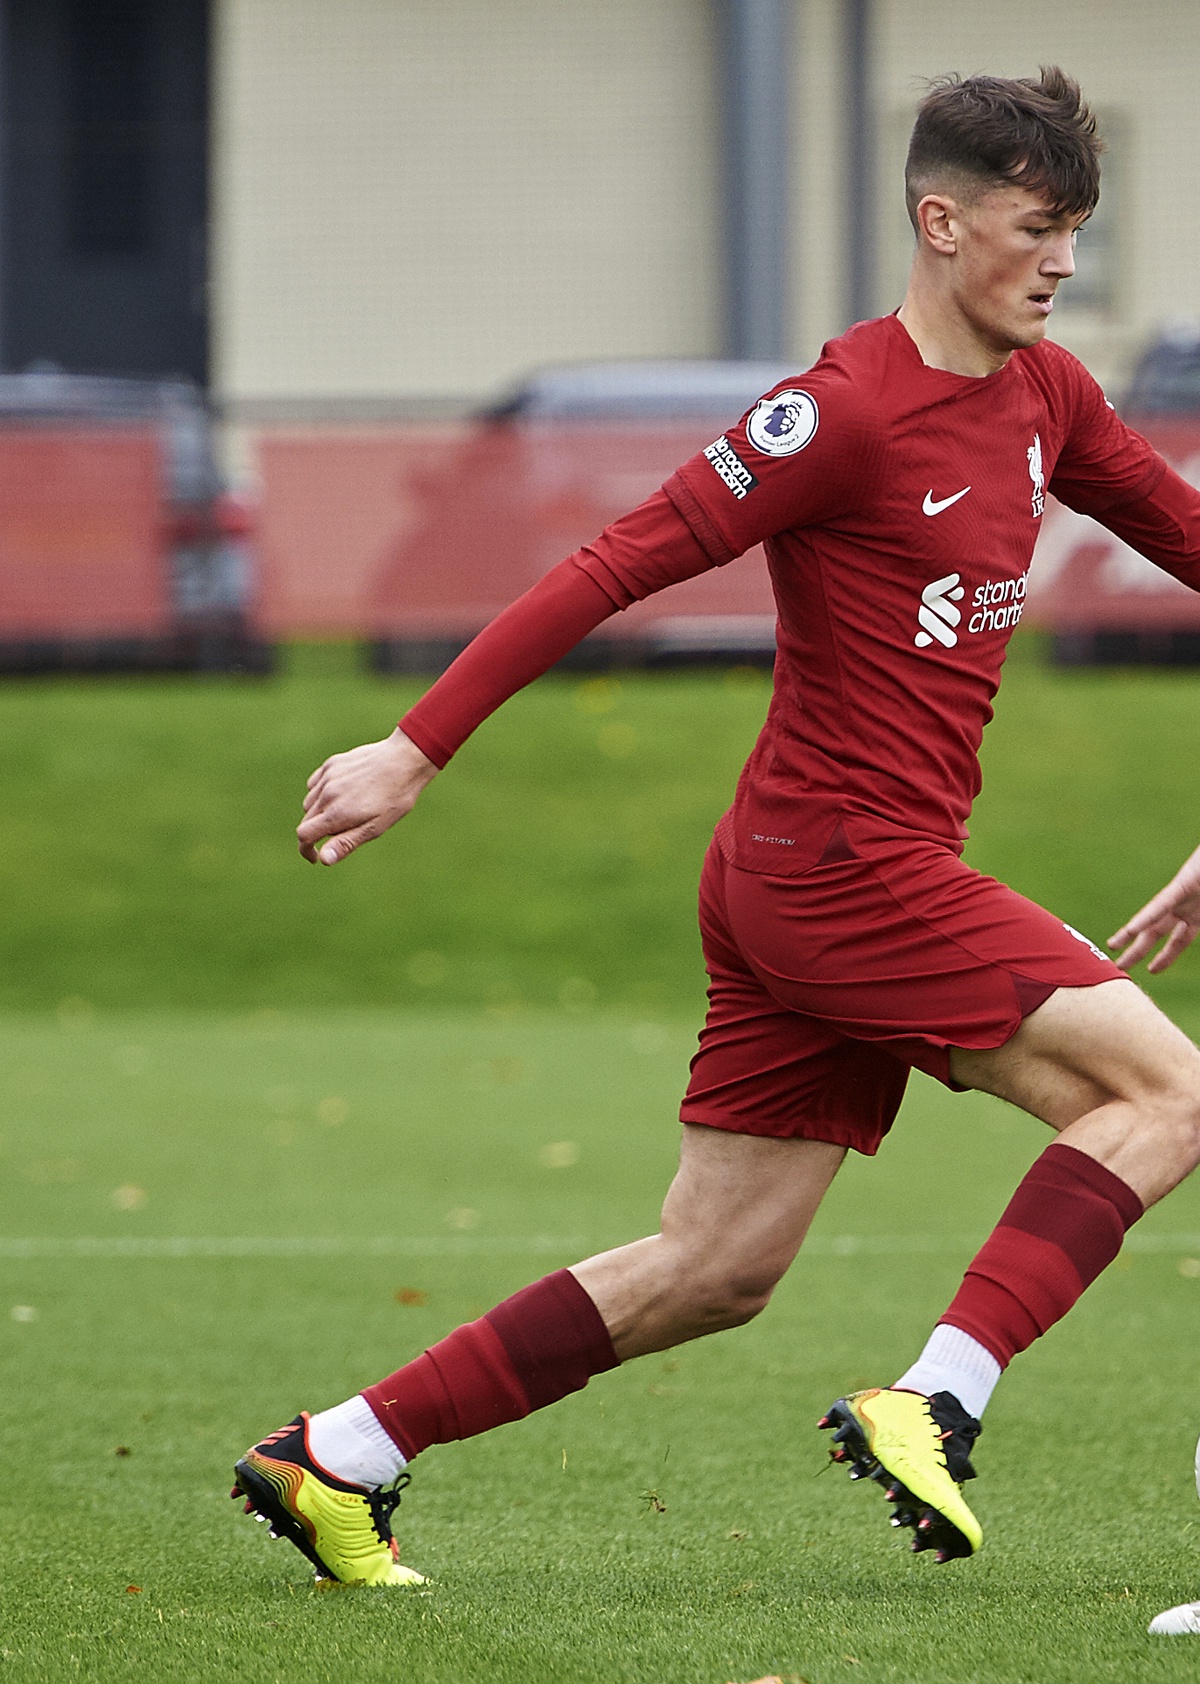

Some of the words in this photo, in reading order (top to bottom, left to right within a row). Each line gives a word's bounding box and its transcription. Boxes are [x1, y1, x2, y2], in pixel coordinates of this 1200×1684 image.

[776, 437, 796, 447] League
[710, 456, 748, 500] racism
[721, 449, 753, 487] room
